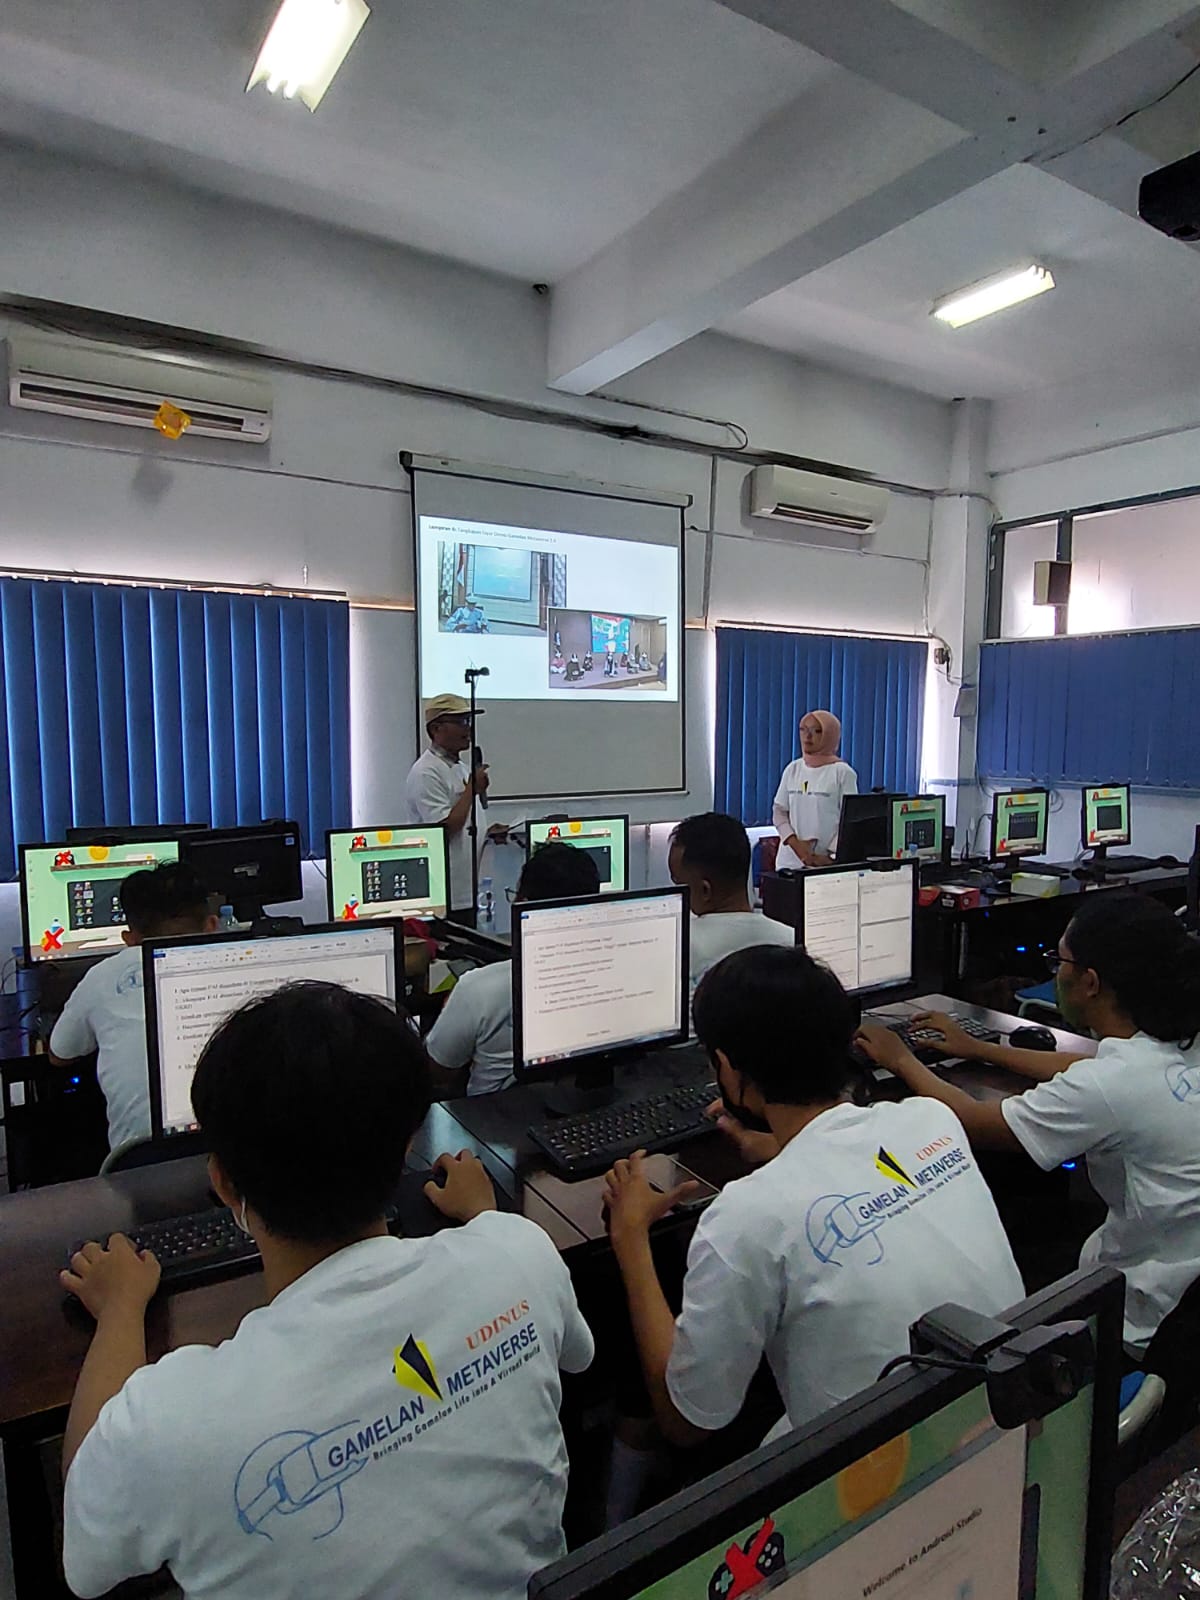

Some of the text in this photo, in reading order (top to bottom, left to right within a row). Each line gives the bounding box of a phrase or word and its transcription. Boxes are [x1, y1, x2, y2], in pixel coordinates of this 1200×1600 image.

[858, 1148, 966, 1220] GAMELAN METAVERSE
[915, 1135, 953, 1161] UDINUS
[464, 1300, 531, 1351] UDINUS
[327, 1322, 538, 1468] GAMELAN METAVERSE
[372, 1431, 413, 1461] Bringing
[414, 1406, 453, 1435] Gamelan
[454, 1394, 470, 1410] Life
[471, 1383, 488, 1397] into
[490, 1378, 497, 1388] A
[863, 1507, 982, 1598] Welcome to Android Studio
